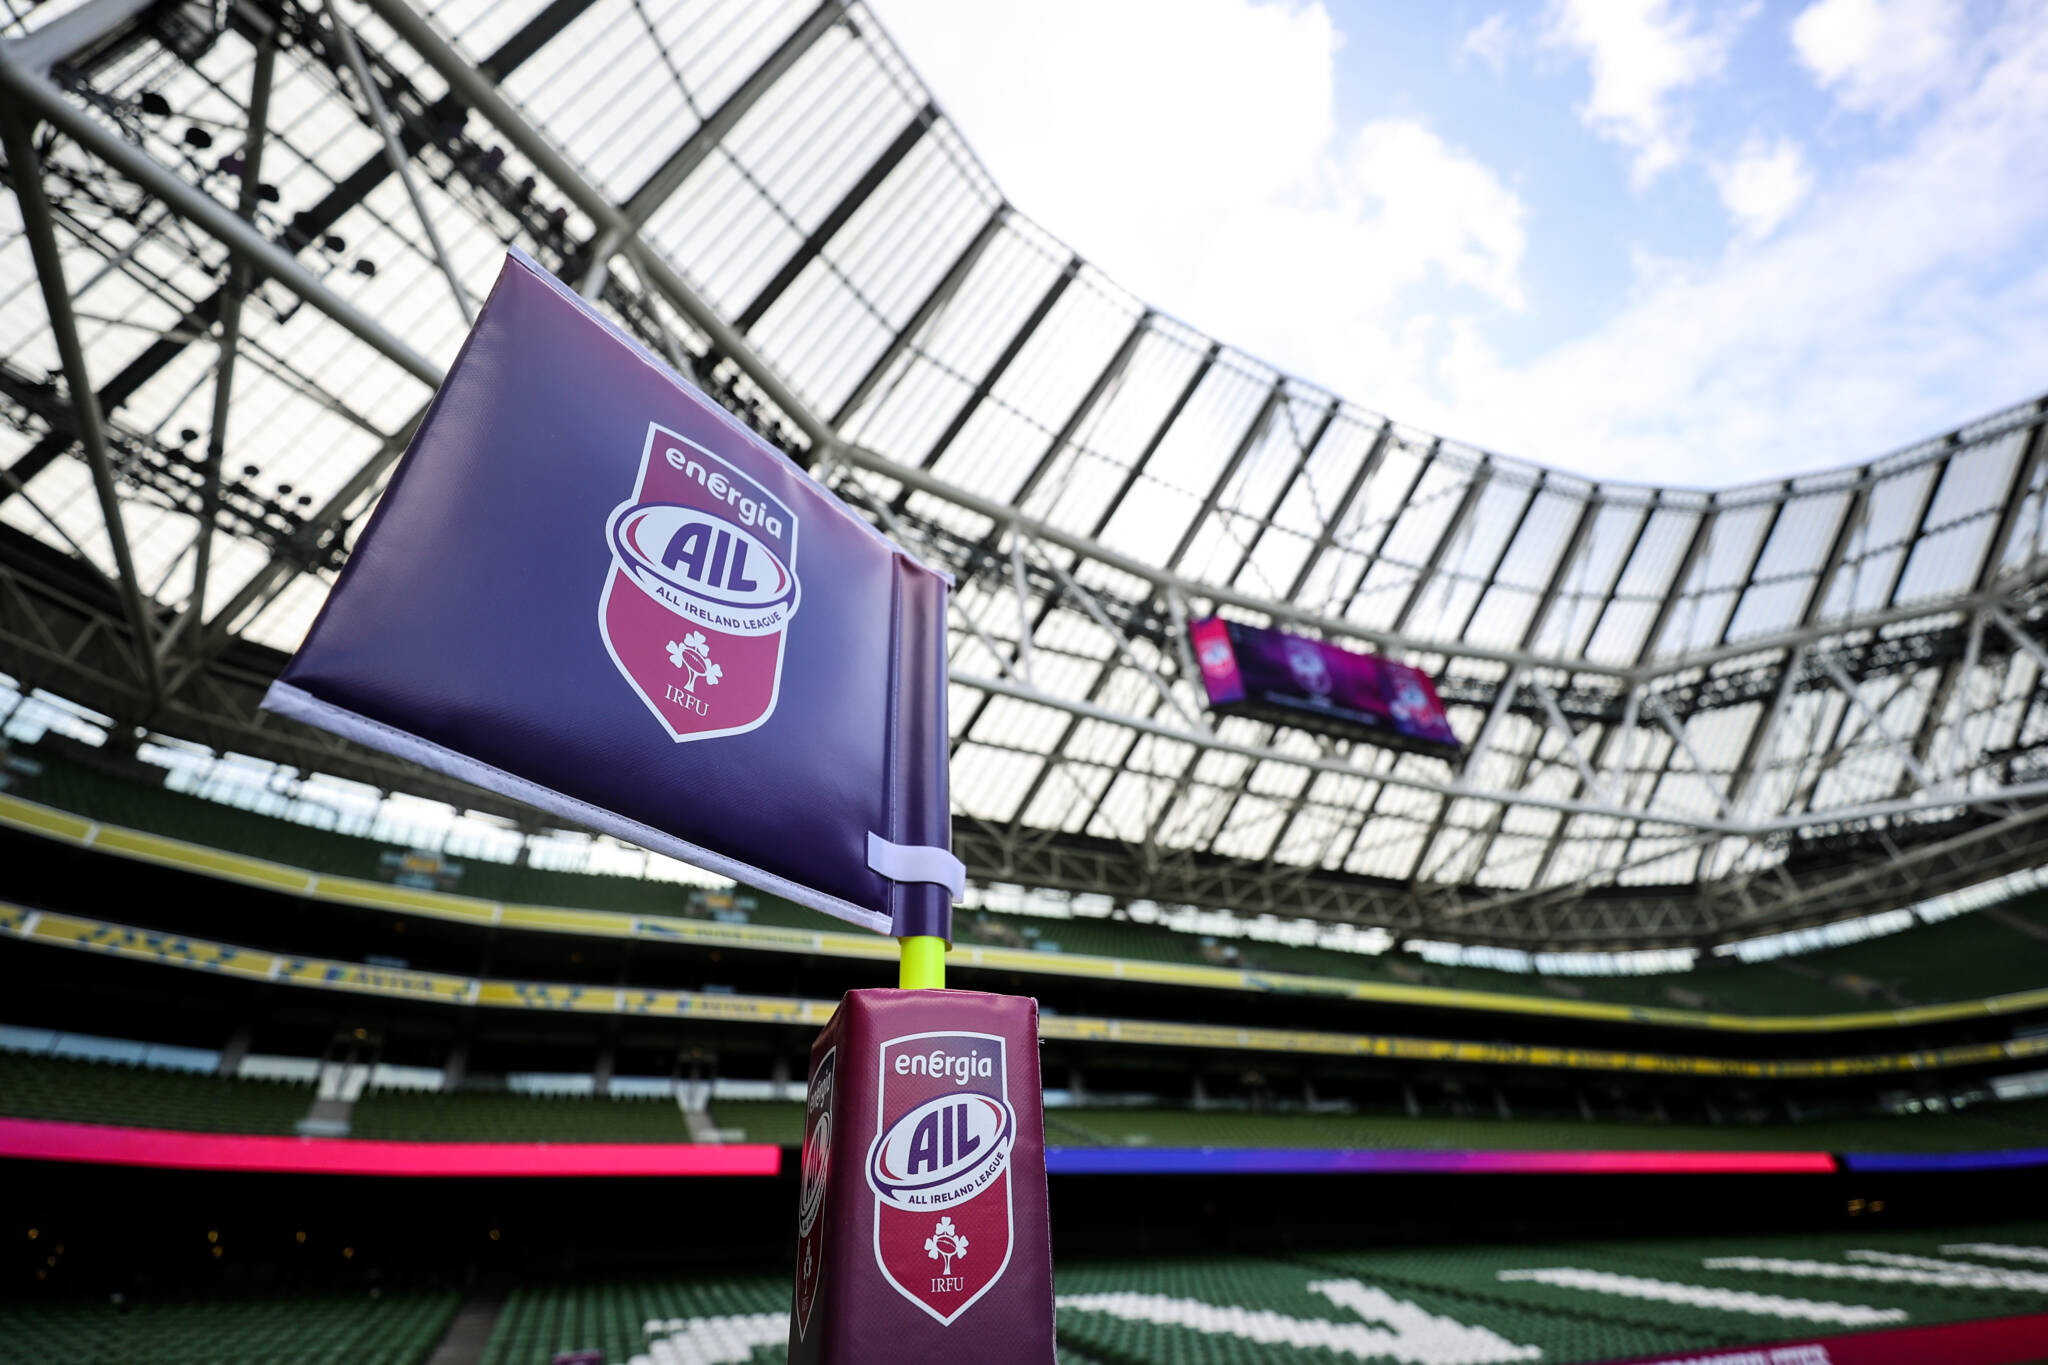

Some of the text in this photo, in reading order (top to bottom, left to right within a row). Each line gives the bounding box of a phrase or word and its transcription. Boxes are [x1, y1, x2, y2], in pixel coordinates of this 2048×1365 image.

[665, 447, 782, 539] energia
[661, 523, 757, 592] AIL
[656, 586, 781, 630] ALL IRELAND LEAGUE
[665, 684, 709, 717] IRFU
[895, 1051, 992, 1086] energia
[907, 1104, 980, 1175] AIL
[908, 1151, 1004, 1205] ALL IRELAND LEAGUE
[930, 1277, 964, 1292] IRFU
